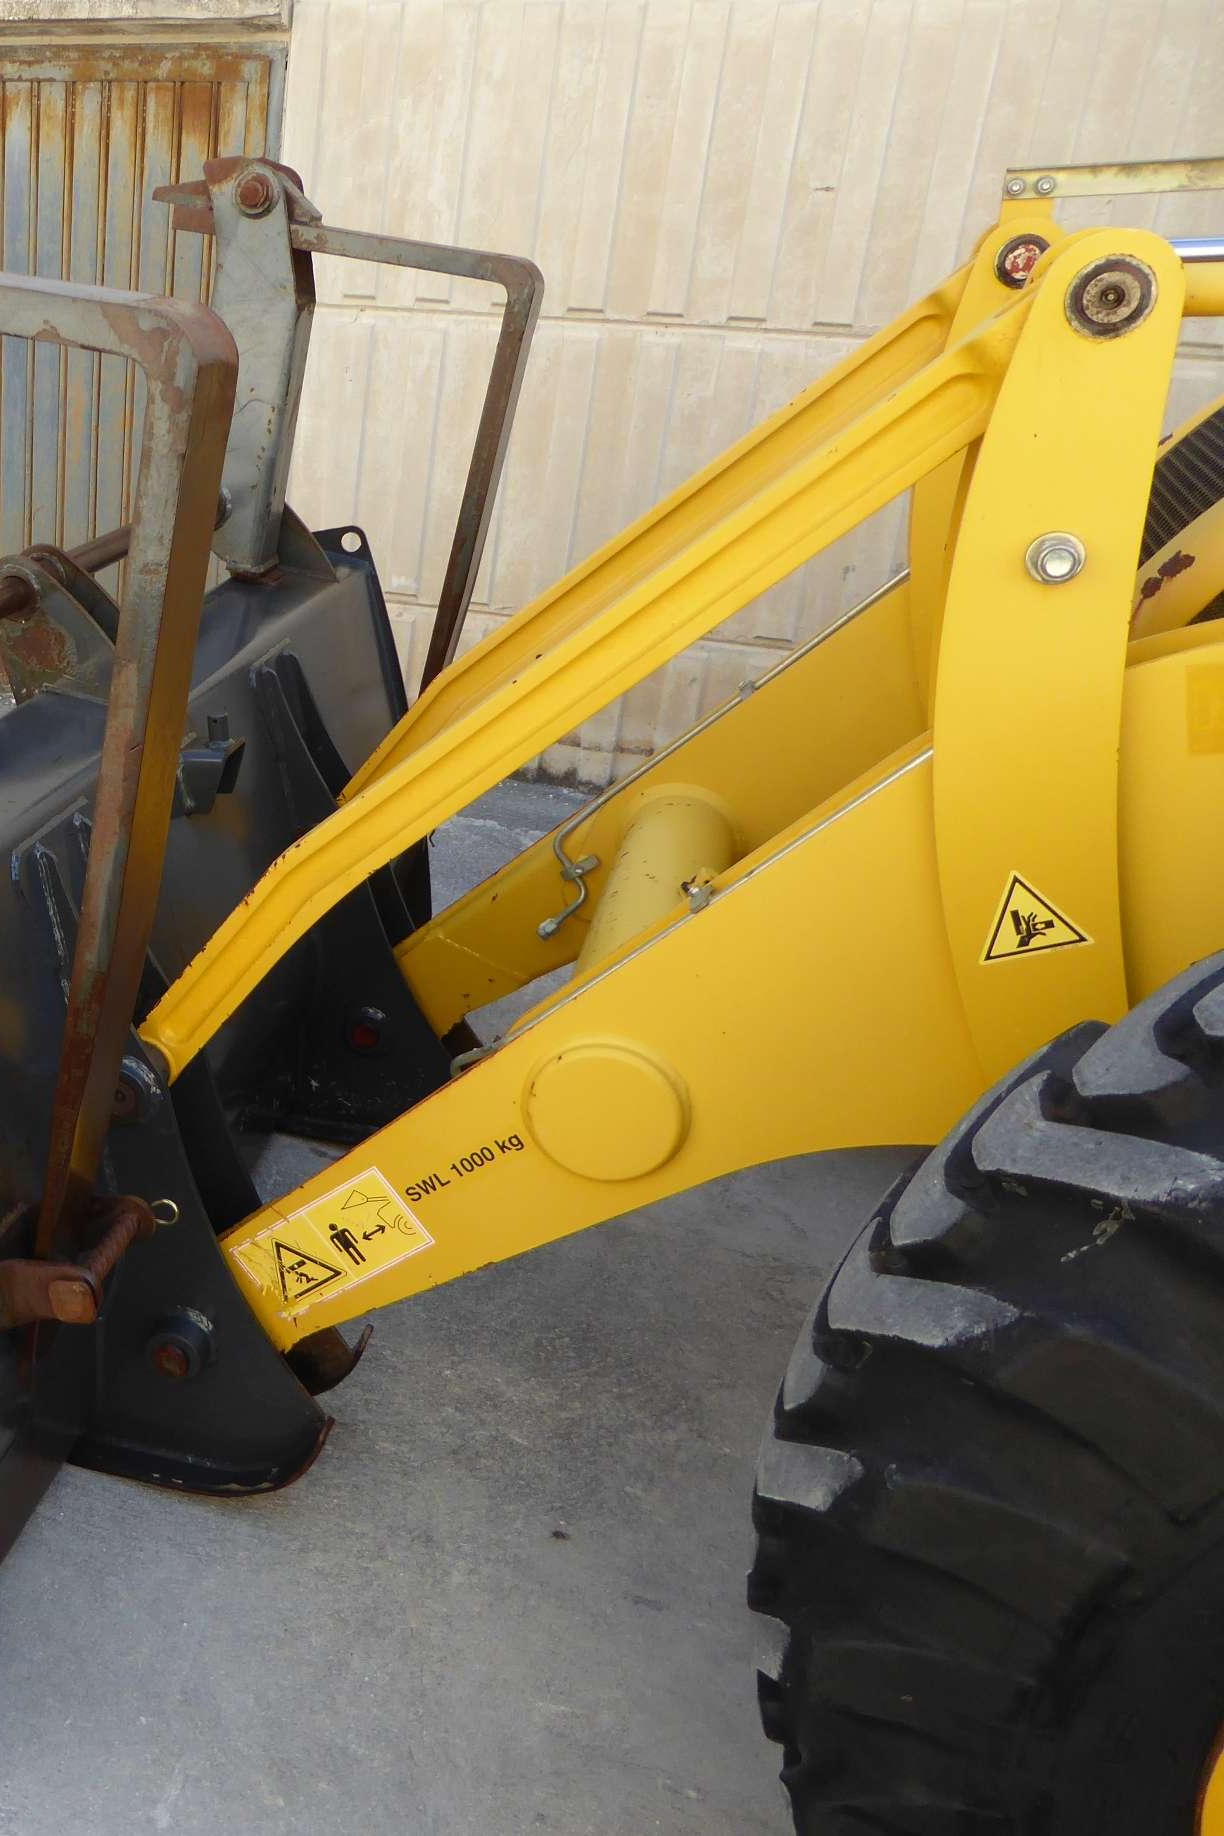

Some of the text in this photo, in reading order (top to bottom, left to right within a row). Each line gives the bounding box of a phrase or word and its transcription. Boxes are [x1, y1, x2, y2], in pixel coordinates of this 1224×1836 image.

[405, 1133, 525, 1202] SWL 1000 kg
